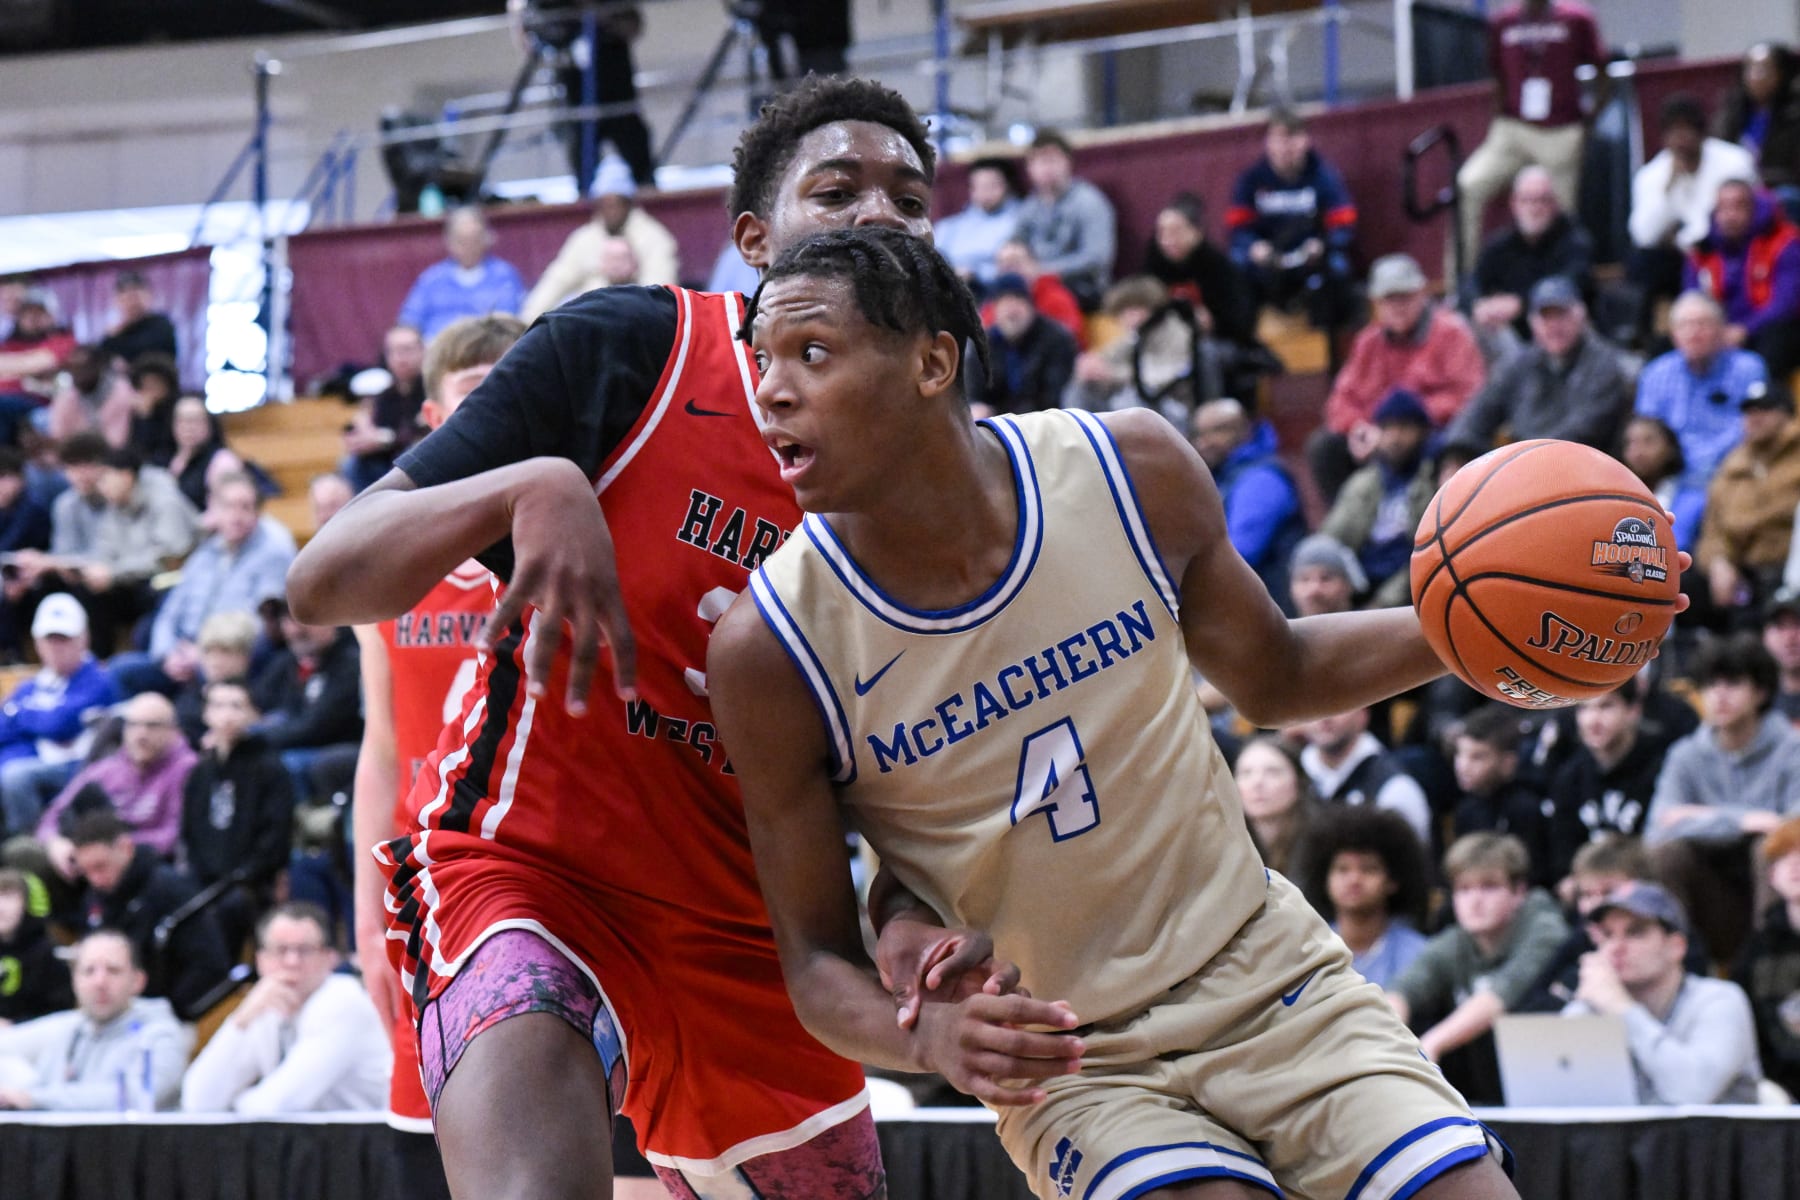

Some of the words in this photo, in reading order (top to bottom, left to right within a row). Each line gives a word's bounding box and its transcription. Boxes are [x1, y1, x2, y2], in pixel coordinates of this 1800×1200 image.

[676, 488, 793, 572] HAR
[1615, 531, 1654, 546] SPALDING
[1592, 541, 1668, 571] HOOPHALL
[395, 613, 489, 648] HARV
[1010, 715, 1101, 844] 4
